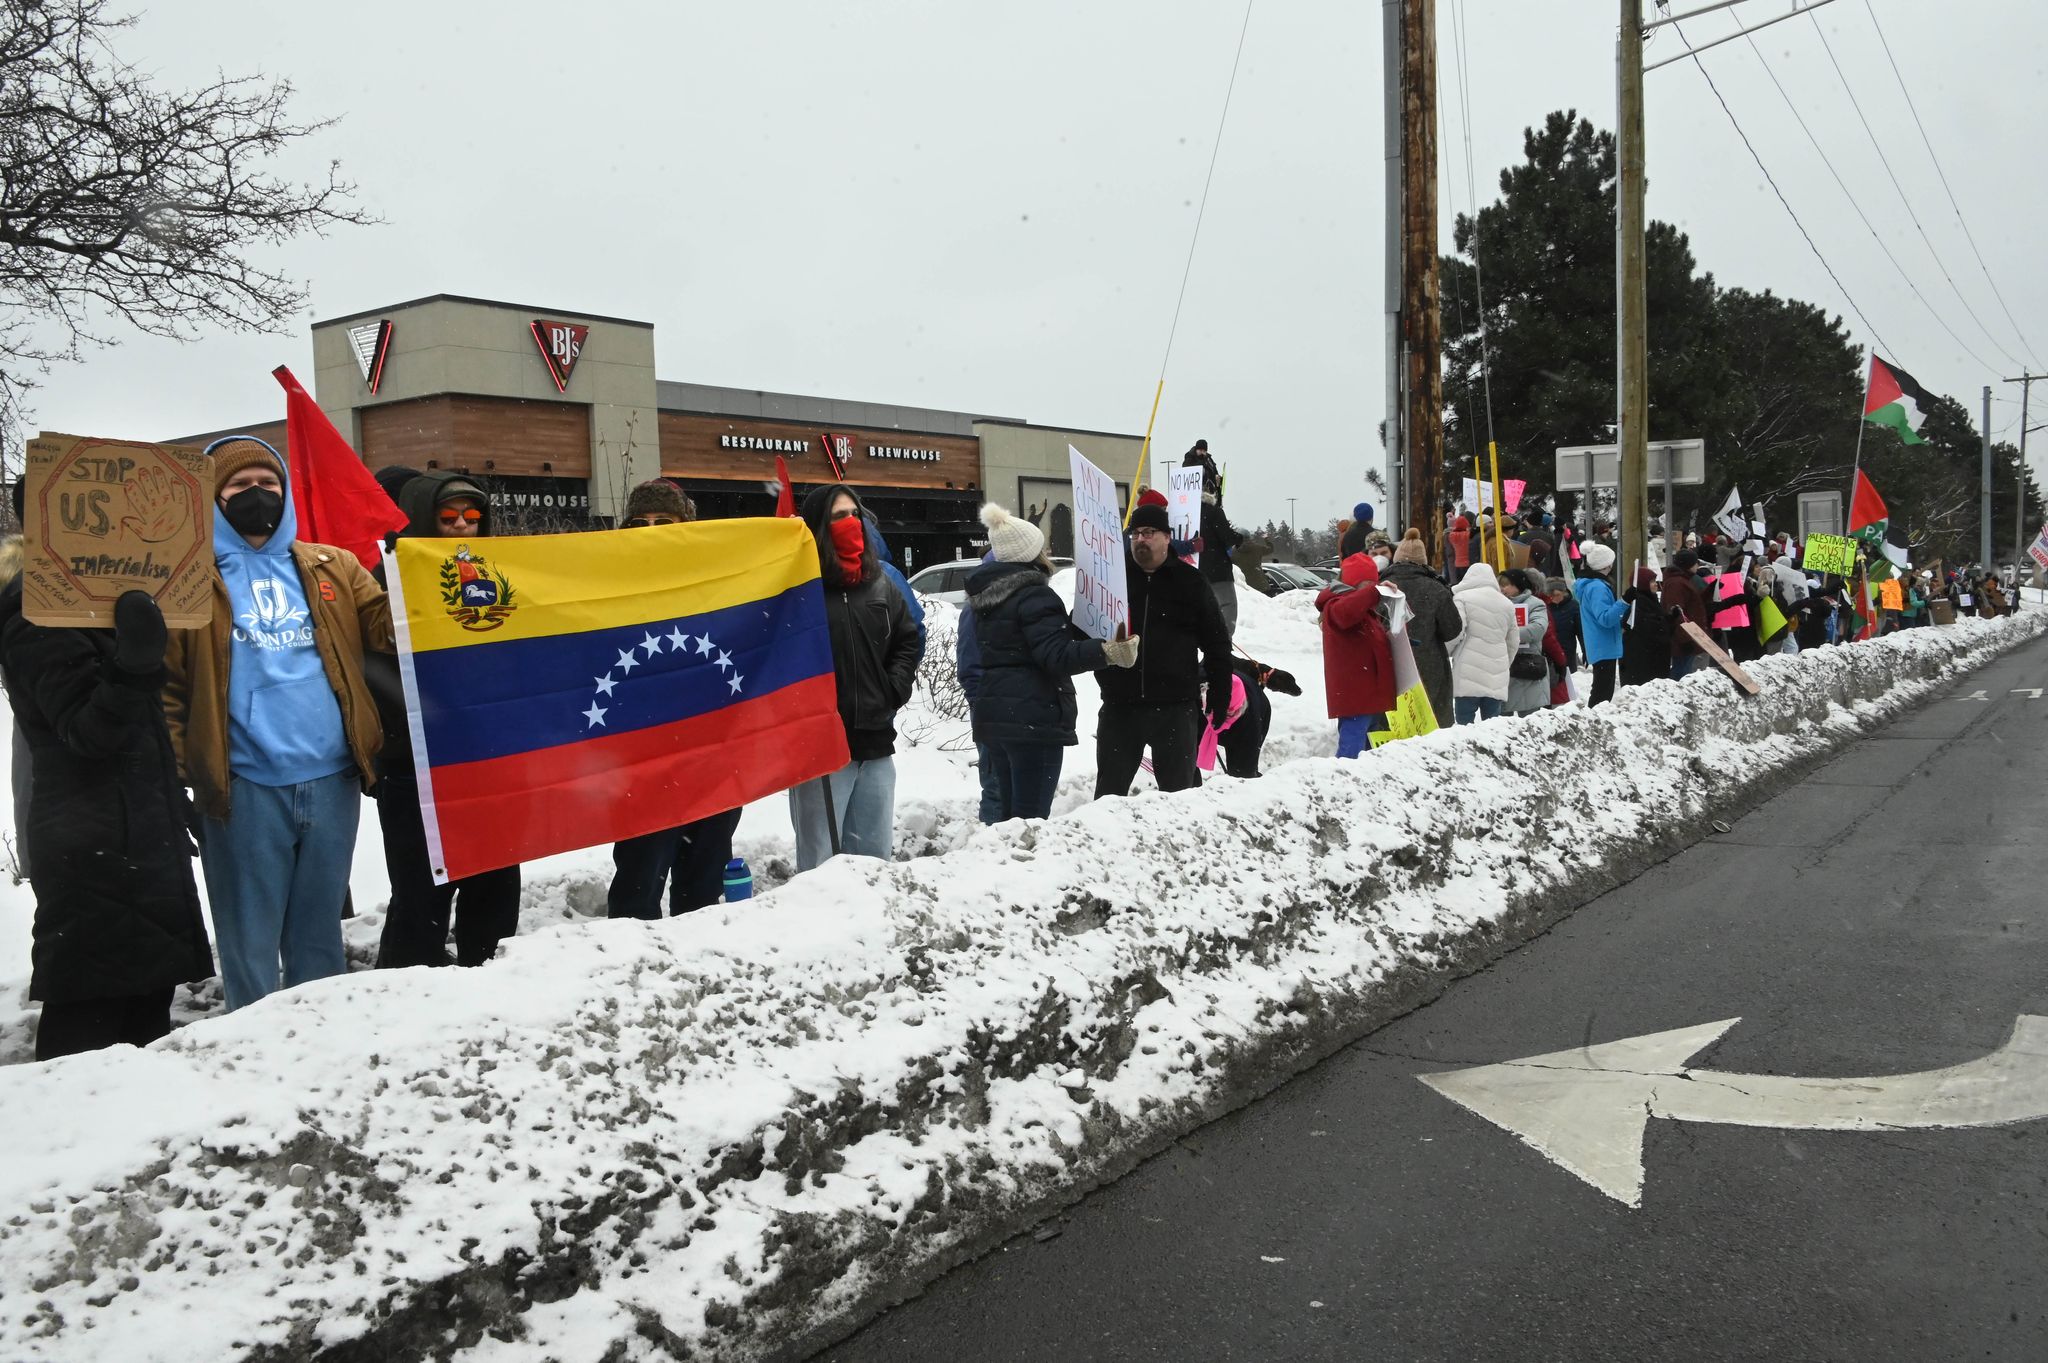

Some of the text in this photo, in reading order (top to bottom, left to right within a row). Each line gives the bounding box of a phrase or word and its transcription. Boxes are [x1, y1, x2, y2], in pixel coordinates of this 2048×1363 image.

[552, 327, 579, 365] BJ's
[721, 435, 809, 452] RESTAURANT
[836, 436, 853, 463] BJ's
[869, 446, 941, 461] BREWHOUSE
[69, 458, 135, 482] STOP
[1081, 461, 1100, 502] MY
[1170, 472, 1201, 491] NO WAR
[60, 490, 116, 536] U.S.
[490, 494, 588, 507] REWHOUSE
[1076, 486, 1121, 543] OUTRAGE
[1817, 544, 1845, 557] MUST
[1093, 551, 1110, 586] FIT
[1077, 568, 1125, 625] ON THIS
